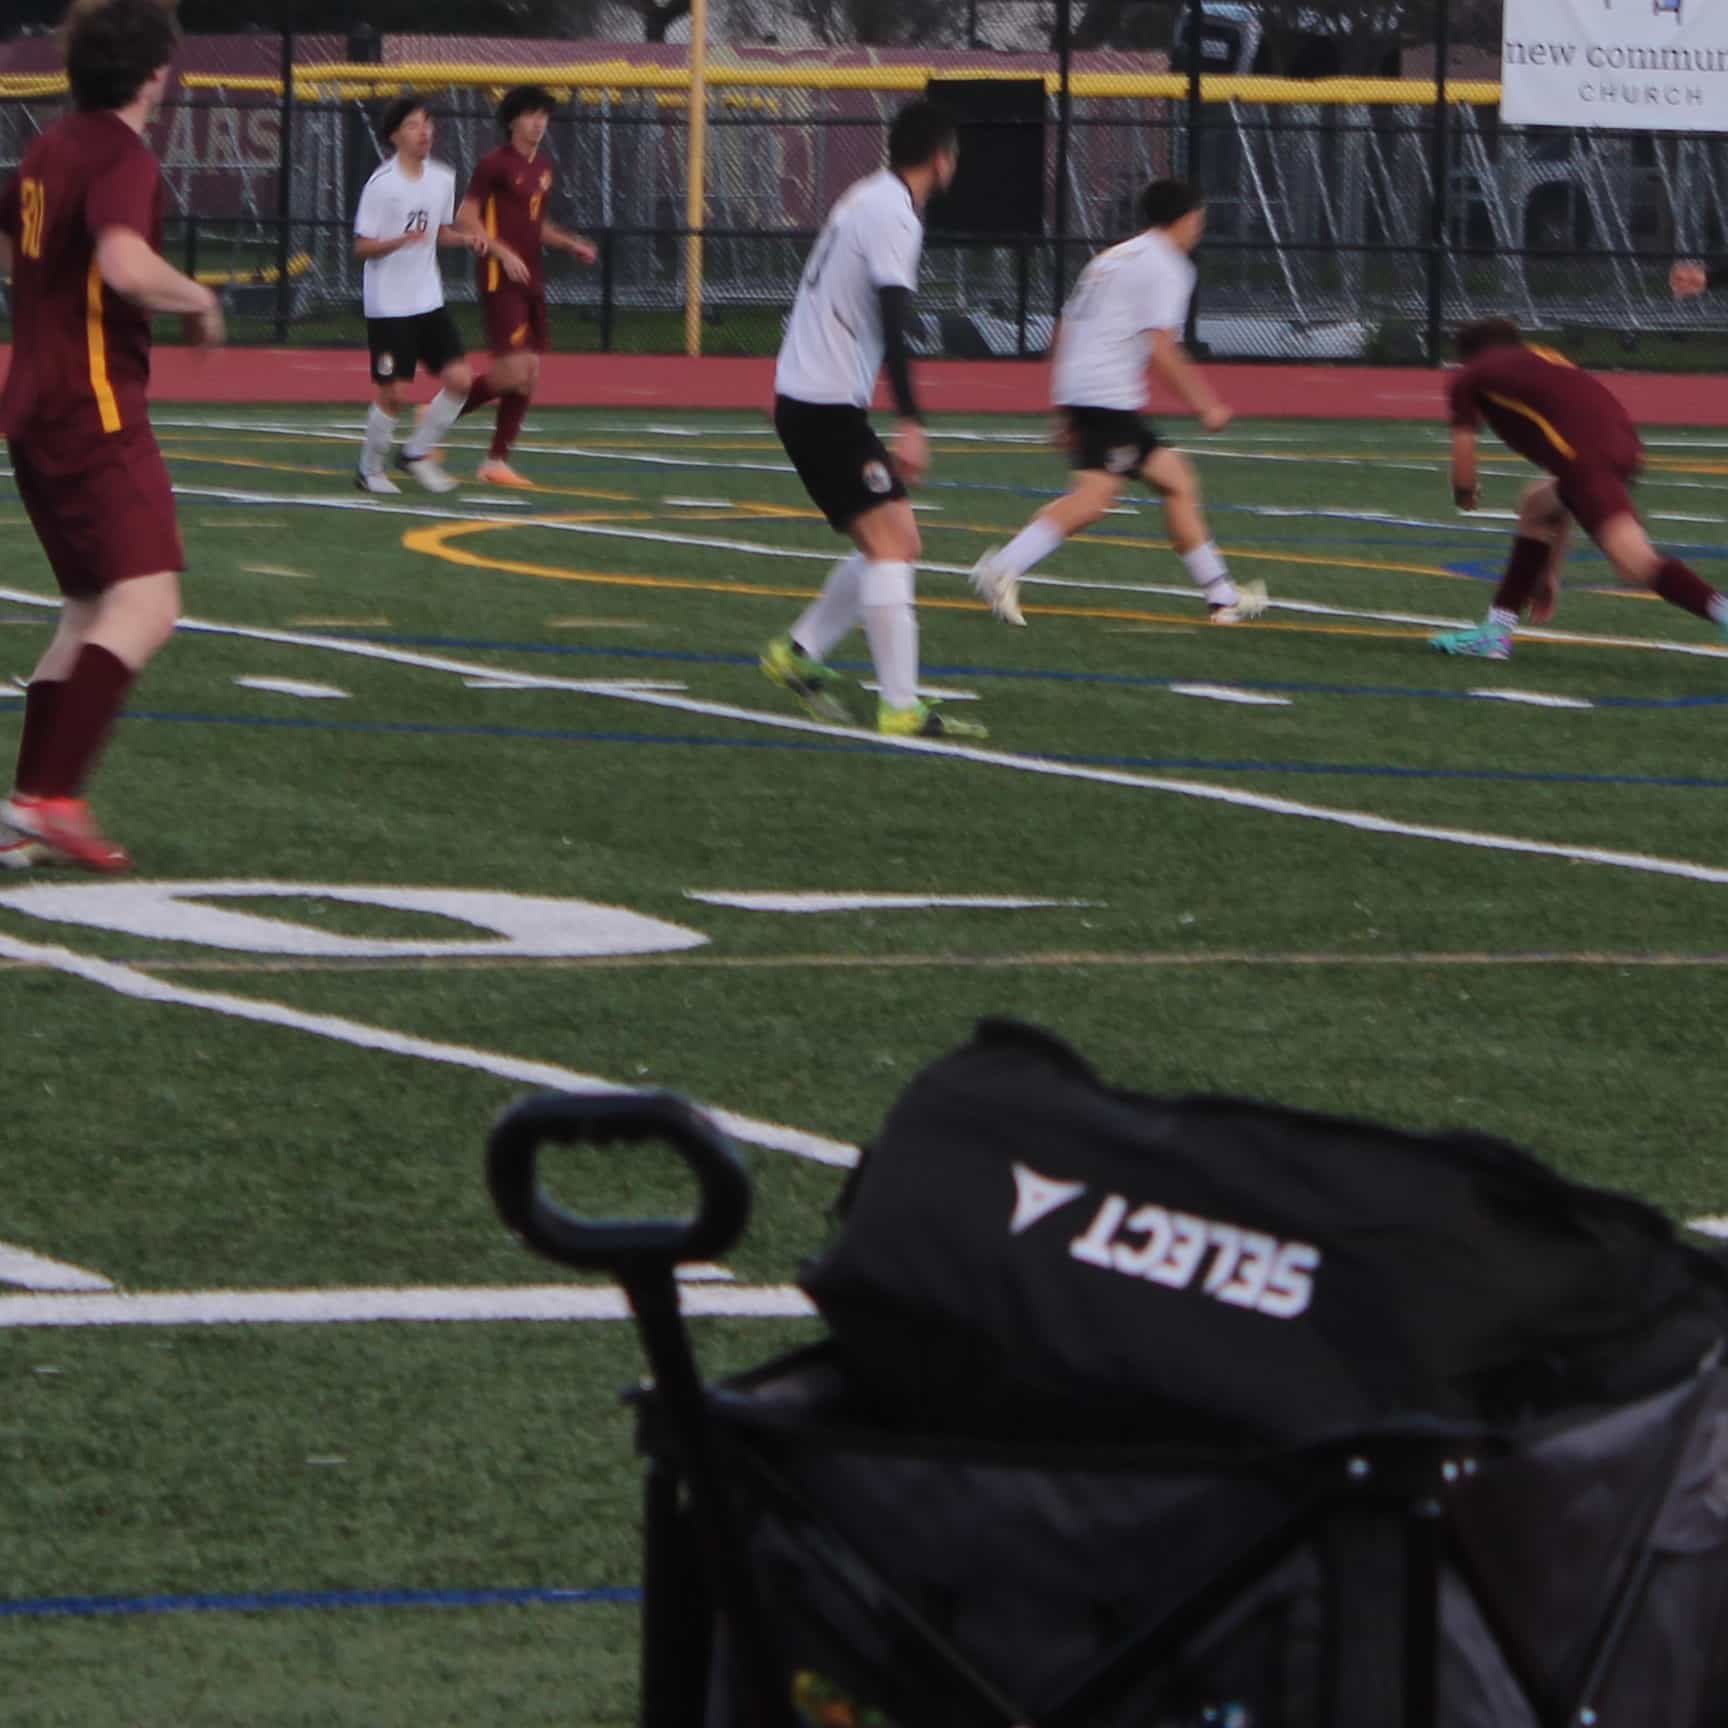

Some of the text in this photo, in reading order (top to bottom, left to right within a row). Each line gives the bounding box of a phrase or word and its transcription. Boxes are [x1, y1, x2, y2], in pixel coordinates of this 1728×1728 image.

[1506, 40, 1575, 67] new
[1578, 83, 1704, 105] CHURCH
[1069, 1194, 1321, 1319] SELECT
